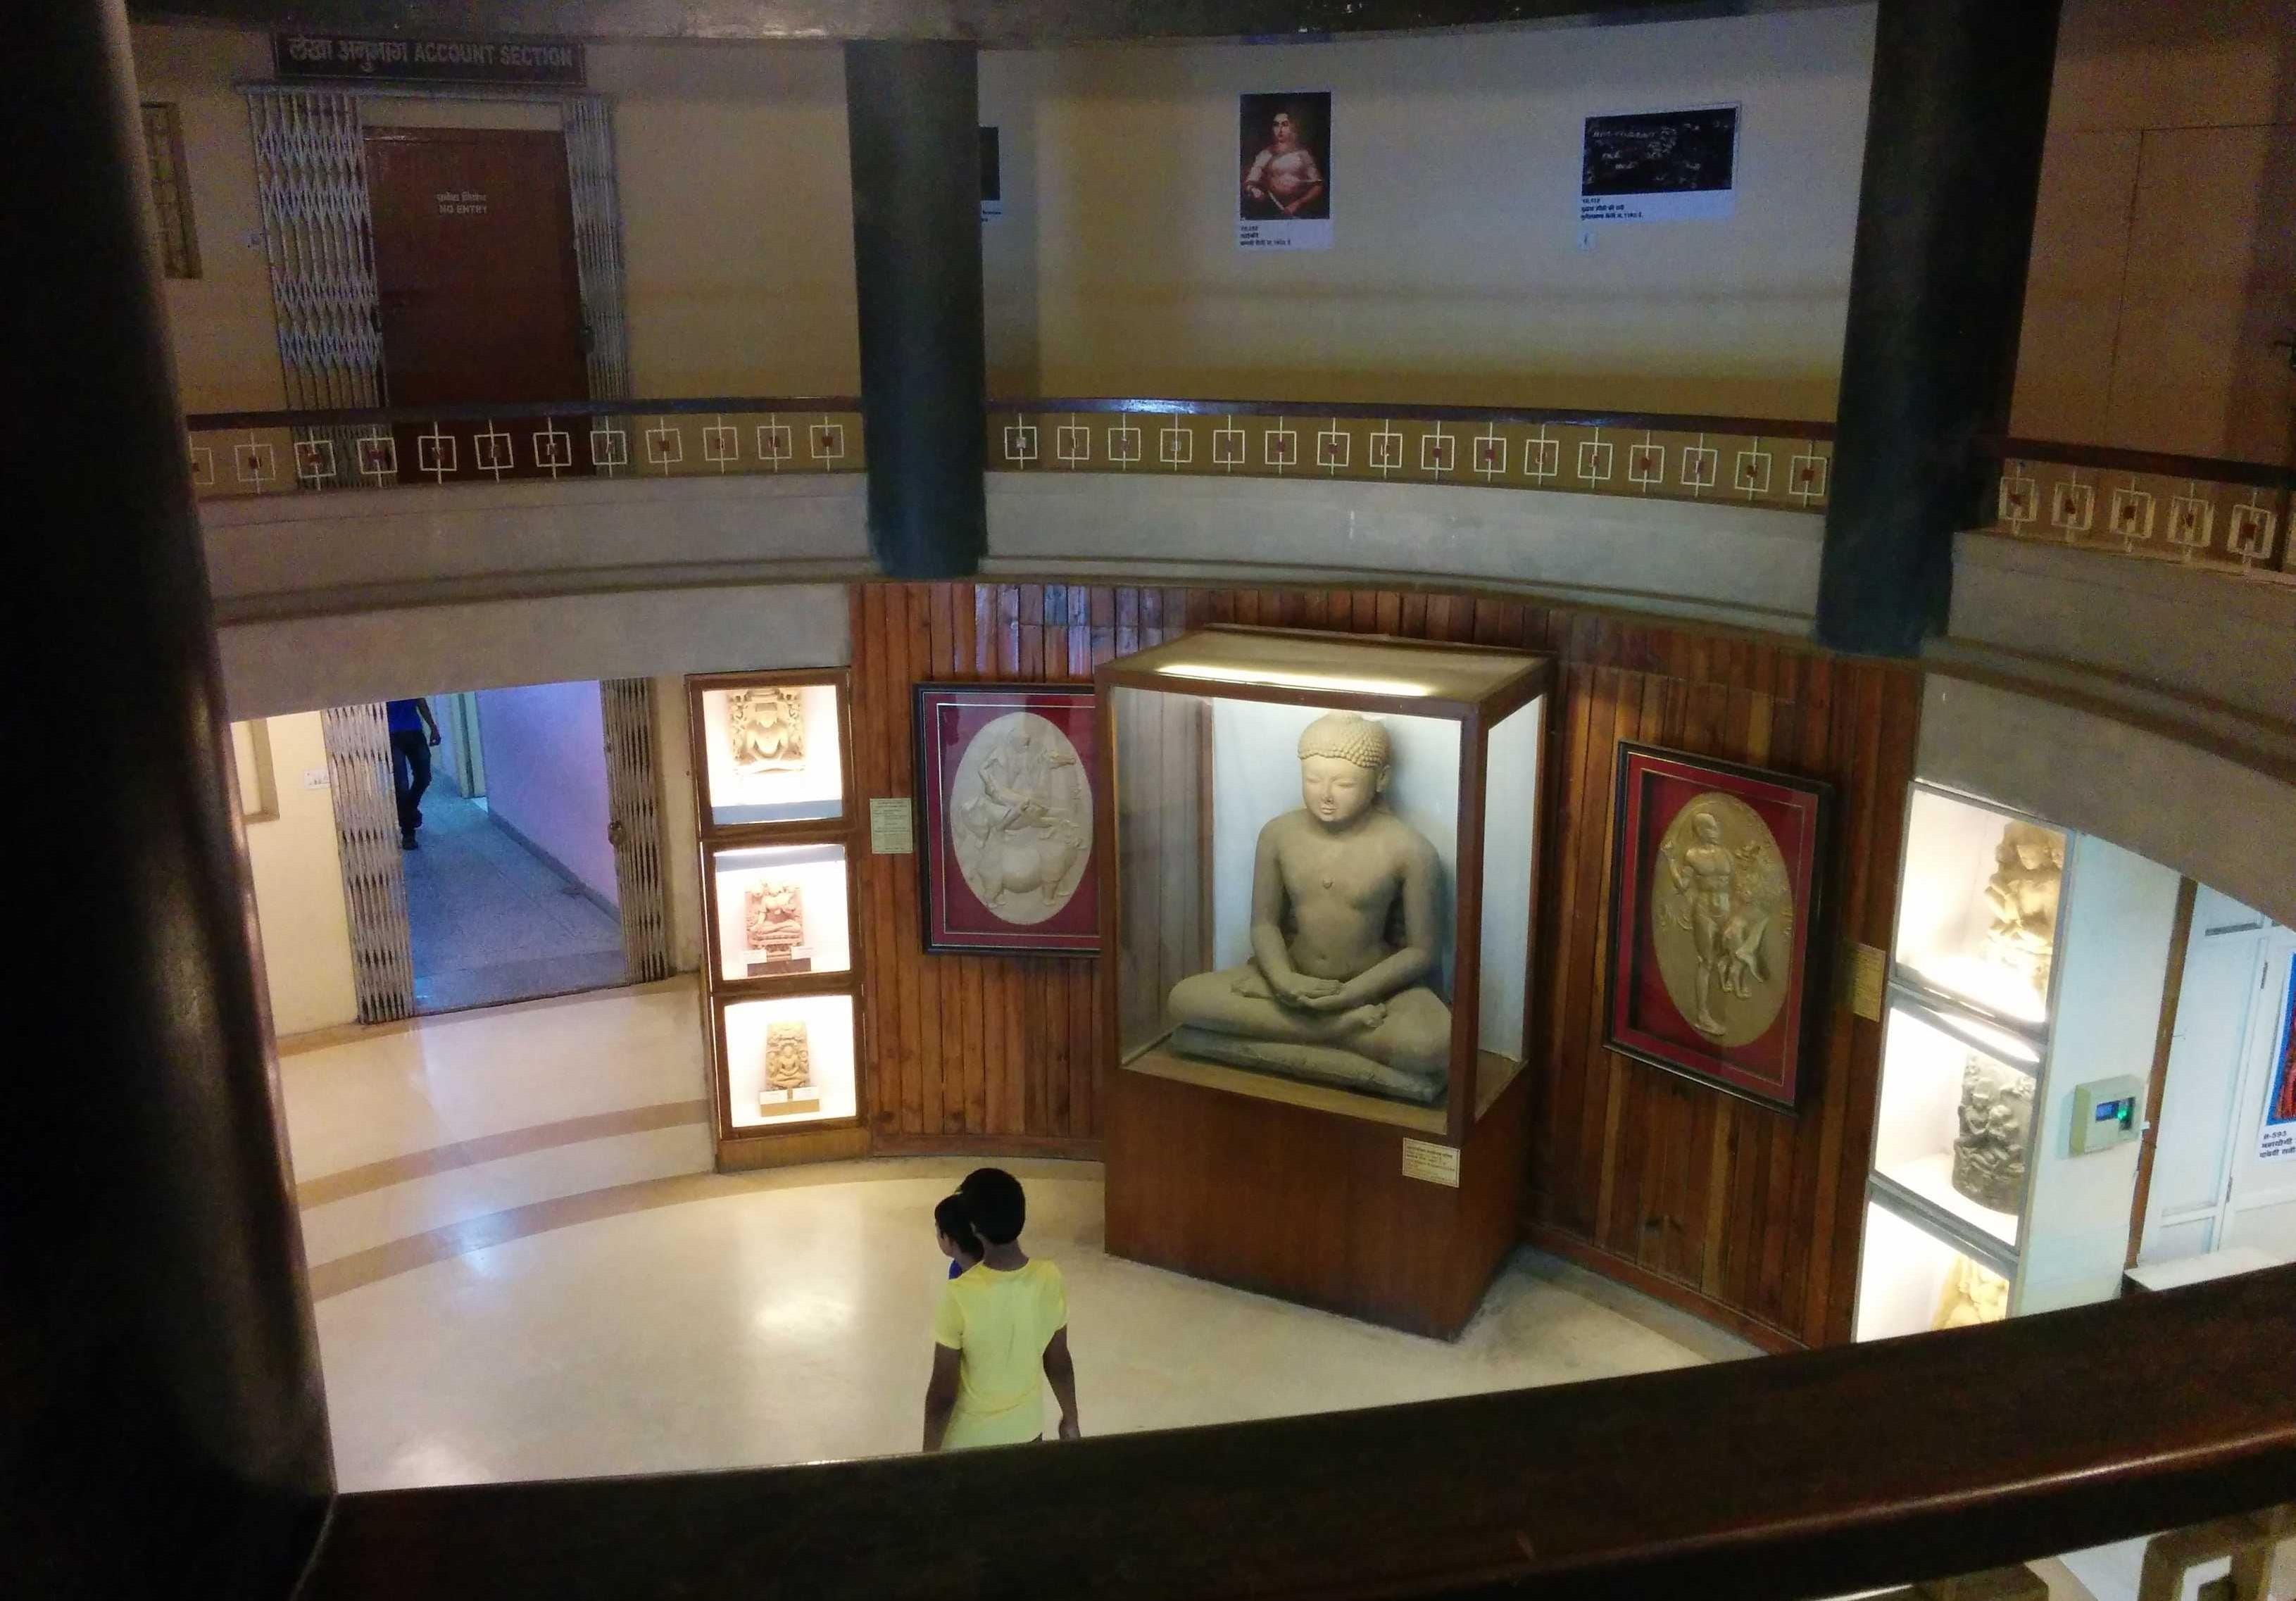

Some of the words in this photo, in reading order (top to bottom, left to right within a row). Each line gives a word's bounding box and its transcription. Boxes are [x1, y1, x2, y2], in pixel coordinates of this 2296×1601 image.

[414, 42, 496, 65] ACCOUNT
[500, 44, 574, 68] SECTION
[439, 204, 454, 214] NO
[456, 204, 487, 214] ENTRY
